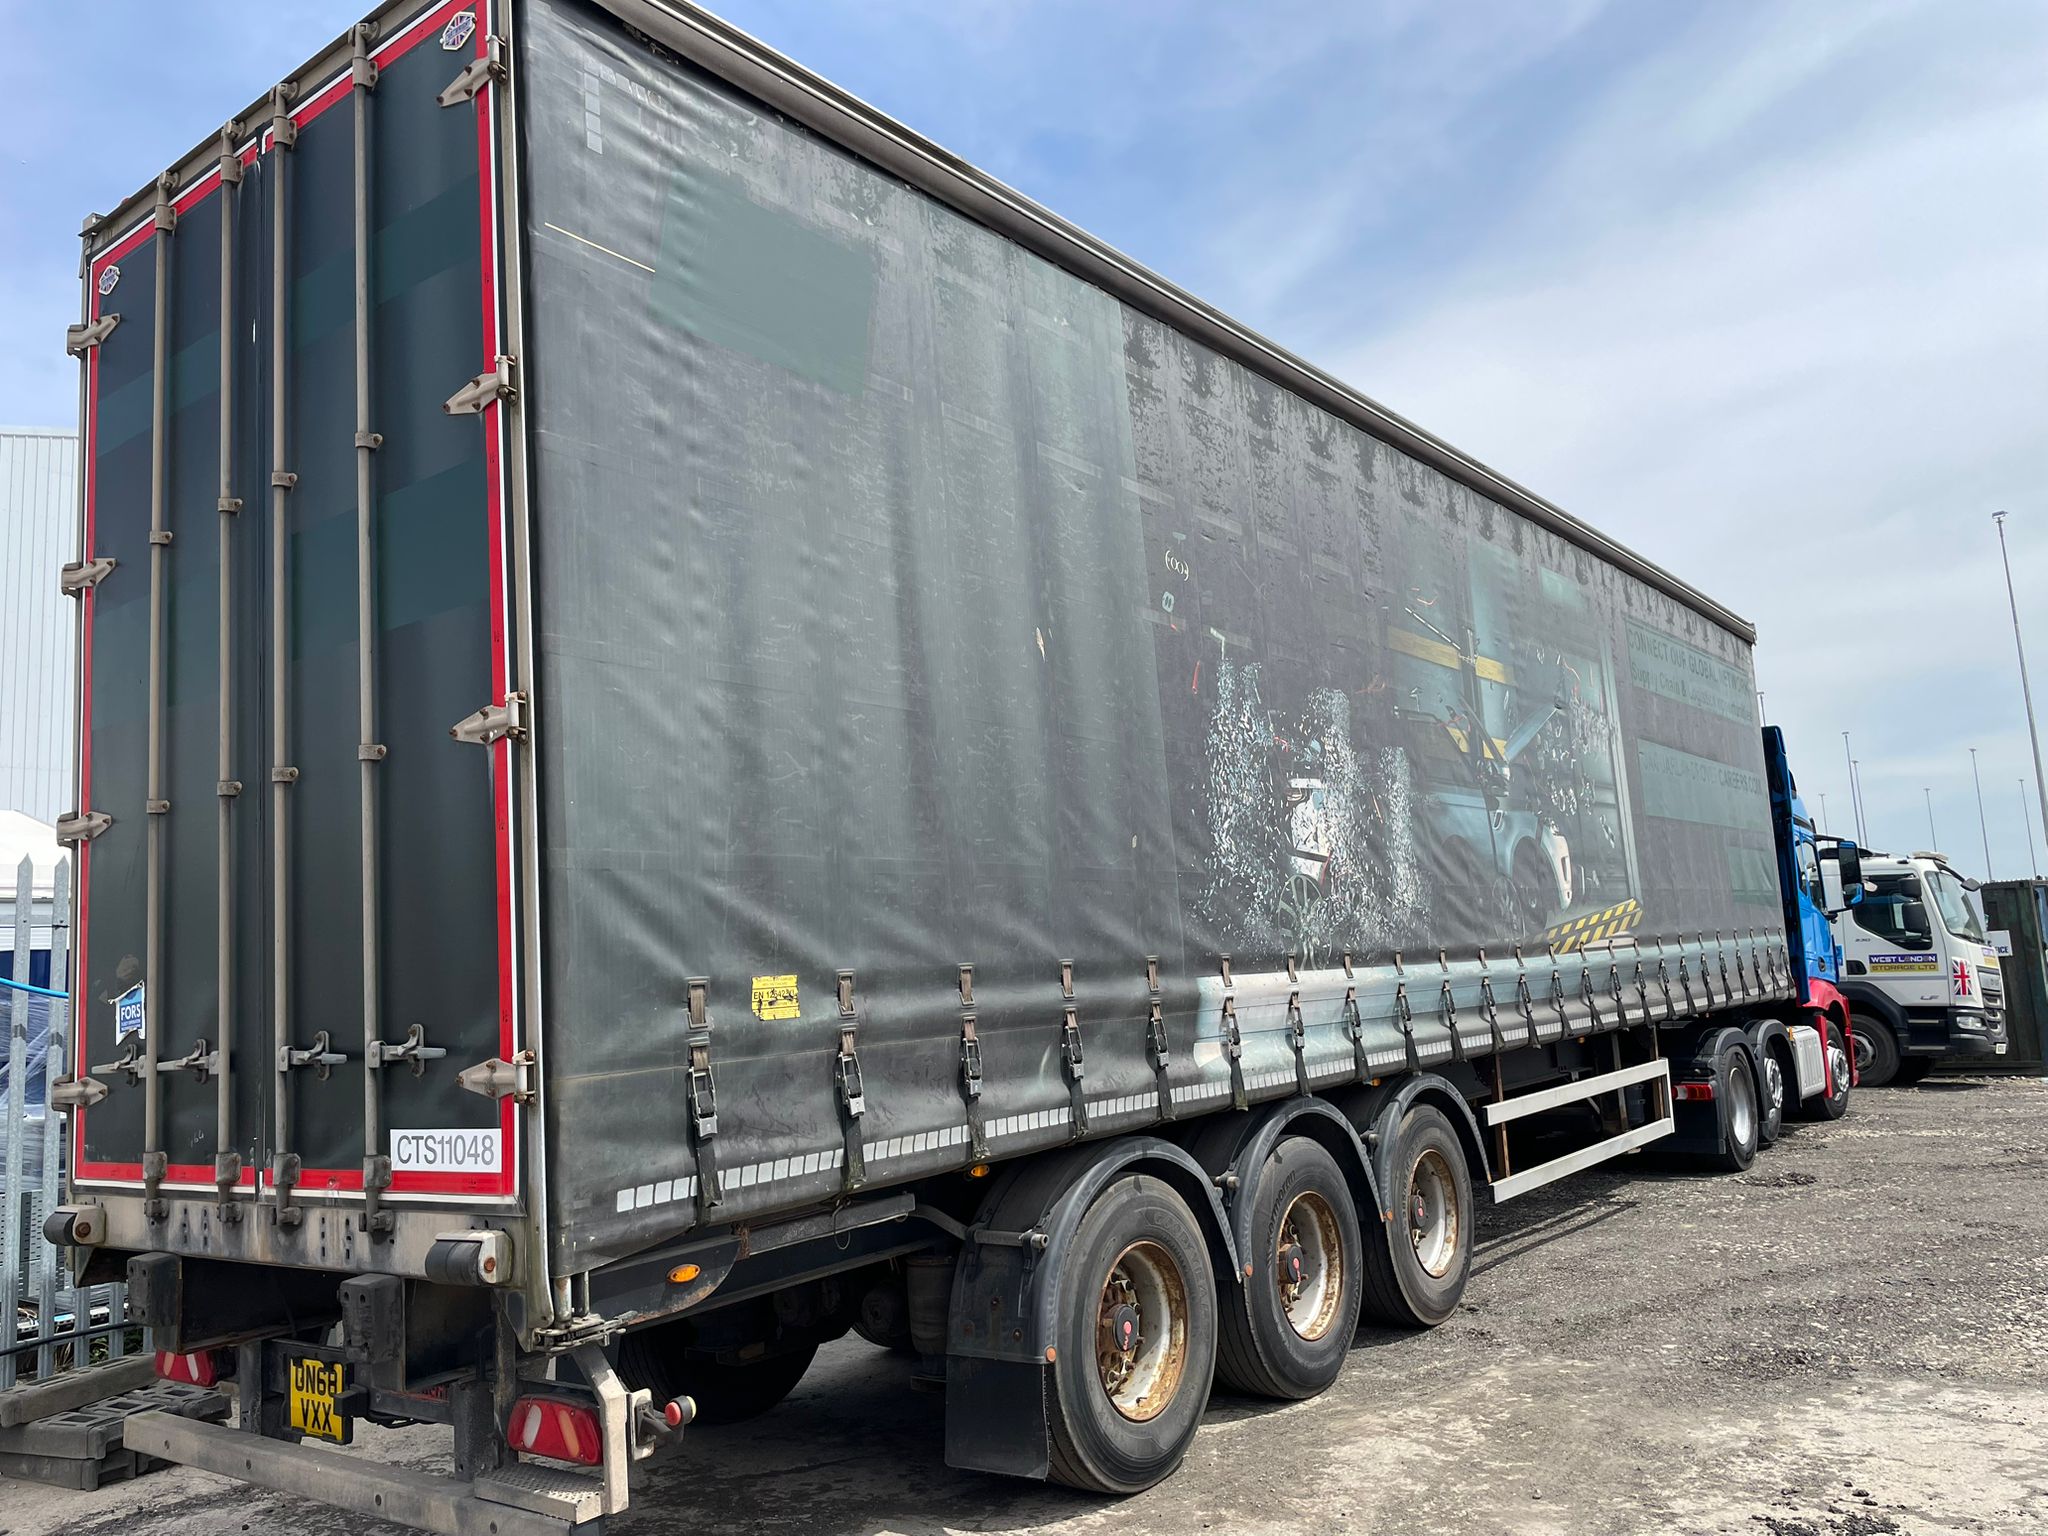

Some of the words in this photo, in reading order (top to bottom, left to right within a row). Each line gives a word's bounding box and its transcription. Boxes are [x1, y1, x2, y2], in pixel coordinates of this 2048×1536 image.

[1628, 629, 1669, 664] CONNECT
[753, 991, 764, 1000] EN
[120, 1003, 141, 1021] FORS
[397, 1134, 495, 1166] CTS11048
[301, 1398, 332, 1432] VXX
